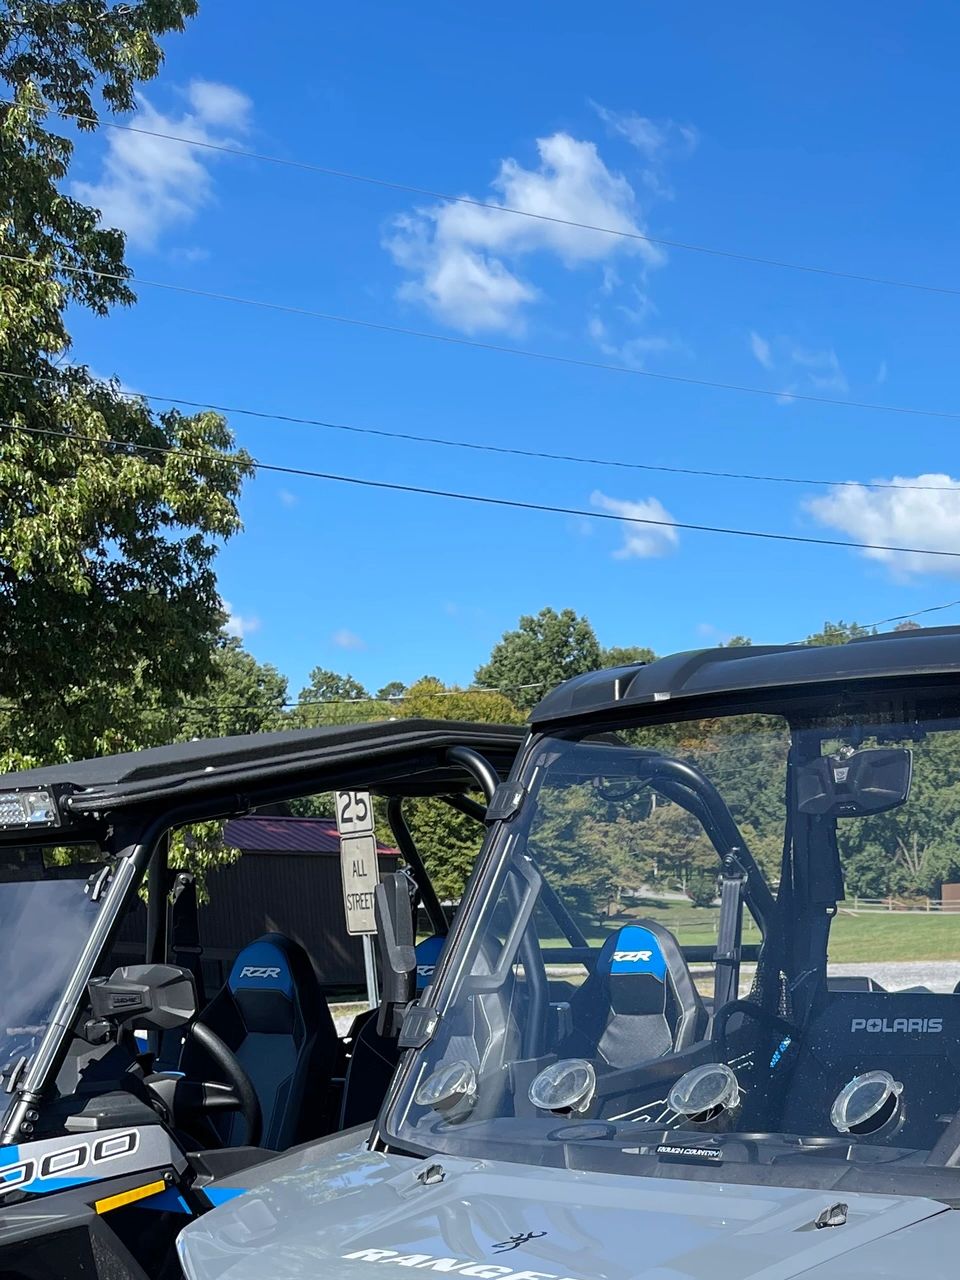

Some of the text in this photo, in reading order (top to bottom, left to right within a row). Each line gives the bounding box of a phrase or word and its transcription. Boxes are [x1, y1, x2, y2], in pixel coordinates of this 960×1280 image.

[338, 791, 368, 823] 25
[352, 859, 368, 878] ALL
[347, 892, 374, 911] STREET
[240, 966, 281, 978] RZR
[416, 965, 436, 976] RZ
[851, 1018, 943, 1033] POLARIS
[656, 1146, 722, 1158] ROUGH COUNTRY
